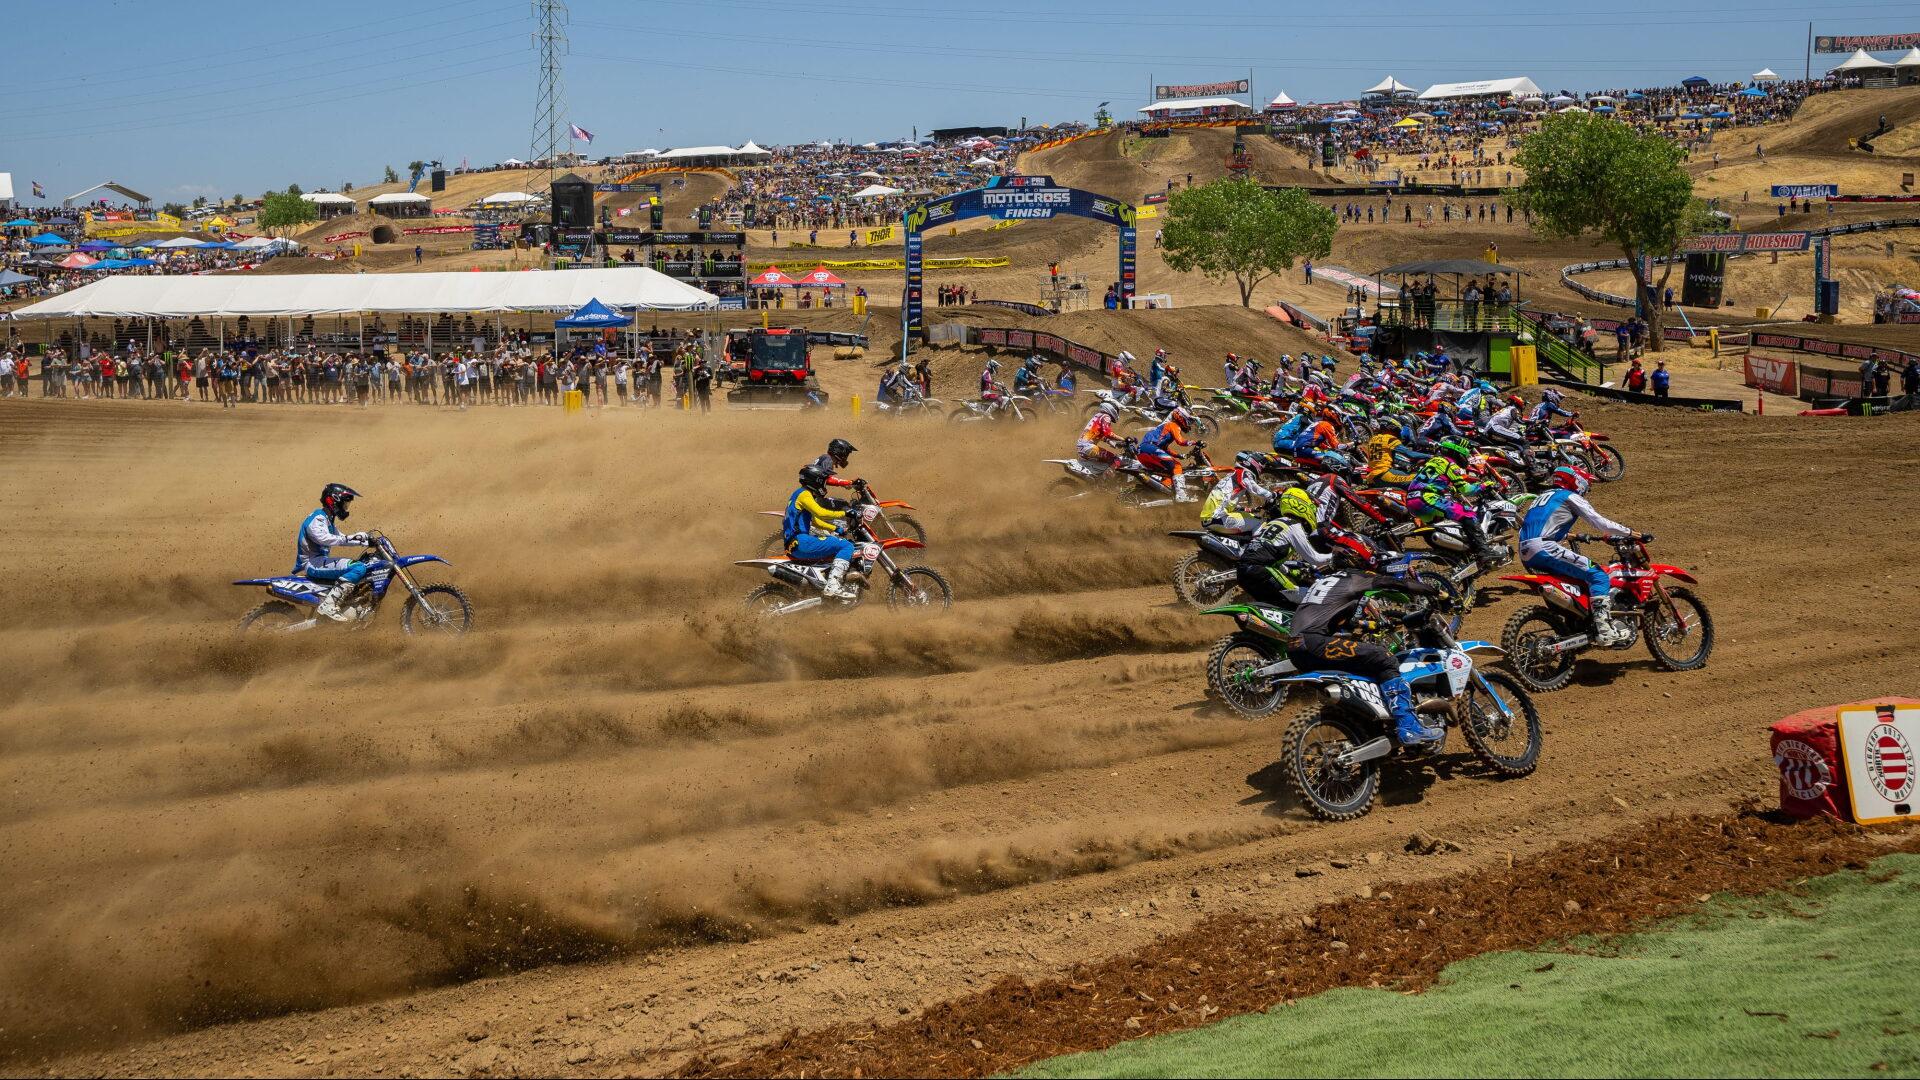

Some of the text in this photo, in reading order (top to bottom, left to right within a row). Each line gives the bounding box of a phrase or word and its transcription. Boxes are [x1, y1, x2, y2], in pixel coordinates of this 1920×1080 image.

[1835, 32, 1920, 48] HANGTO
[1169, 81, 1238, 95] HANGTOWN
[983, 192, 1071, 204] MOTOCROSS
[1790, 185, 1831, 196] YAMAHA
[1005, 208, 1052, 218] FINISH
[870, 227, 891, 243] THOR
[1745, 234, 1805, 249] HOLESHOT
[1757, 334, 1800, 347] MOTOSPORT
[1748, 356, 1788, 382] FLY
[1830, 378, 1862, 399] MOTOSPORT
[1260, 608, 1283, 624] 158
[1866, 731, 1879, 772] DIGGERS
[1874, 749, 1885, 778] NORTH
[1894, 743, 1914, 800] MOTORCYCLE
[1872, 776, 1888, 797] DIRT
